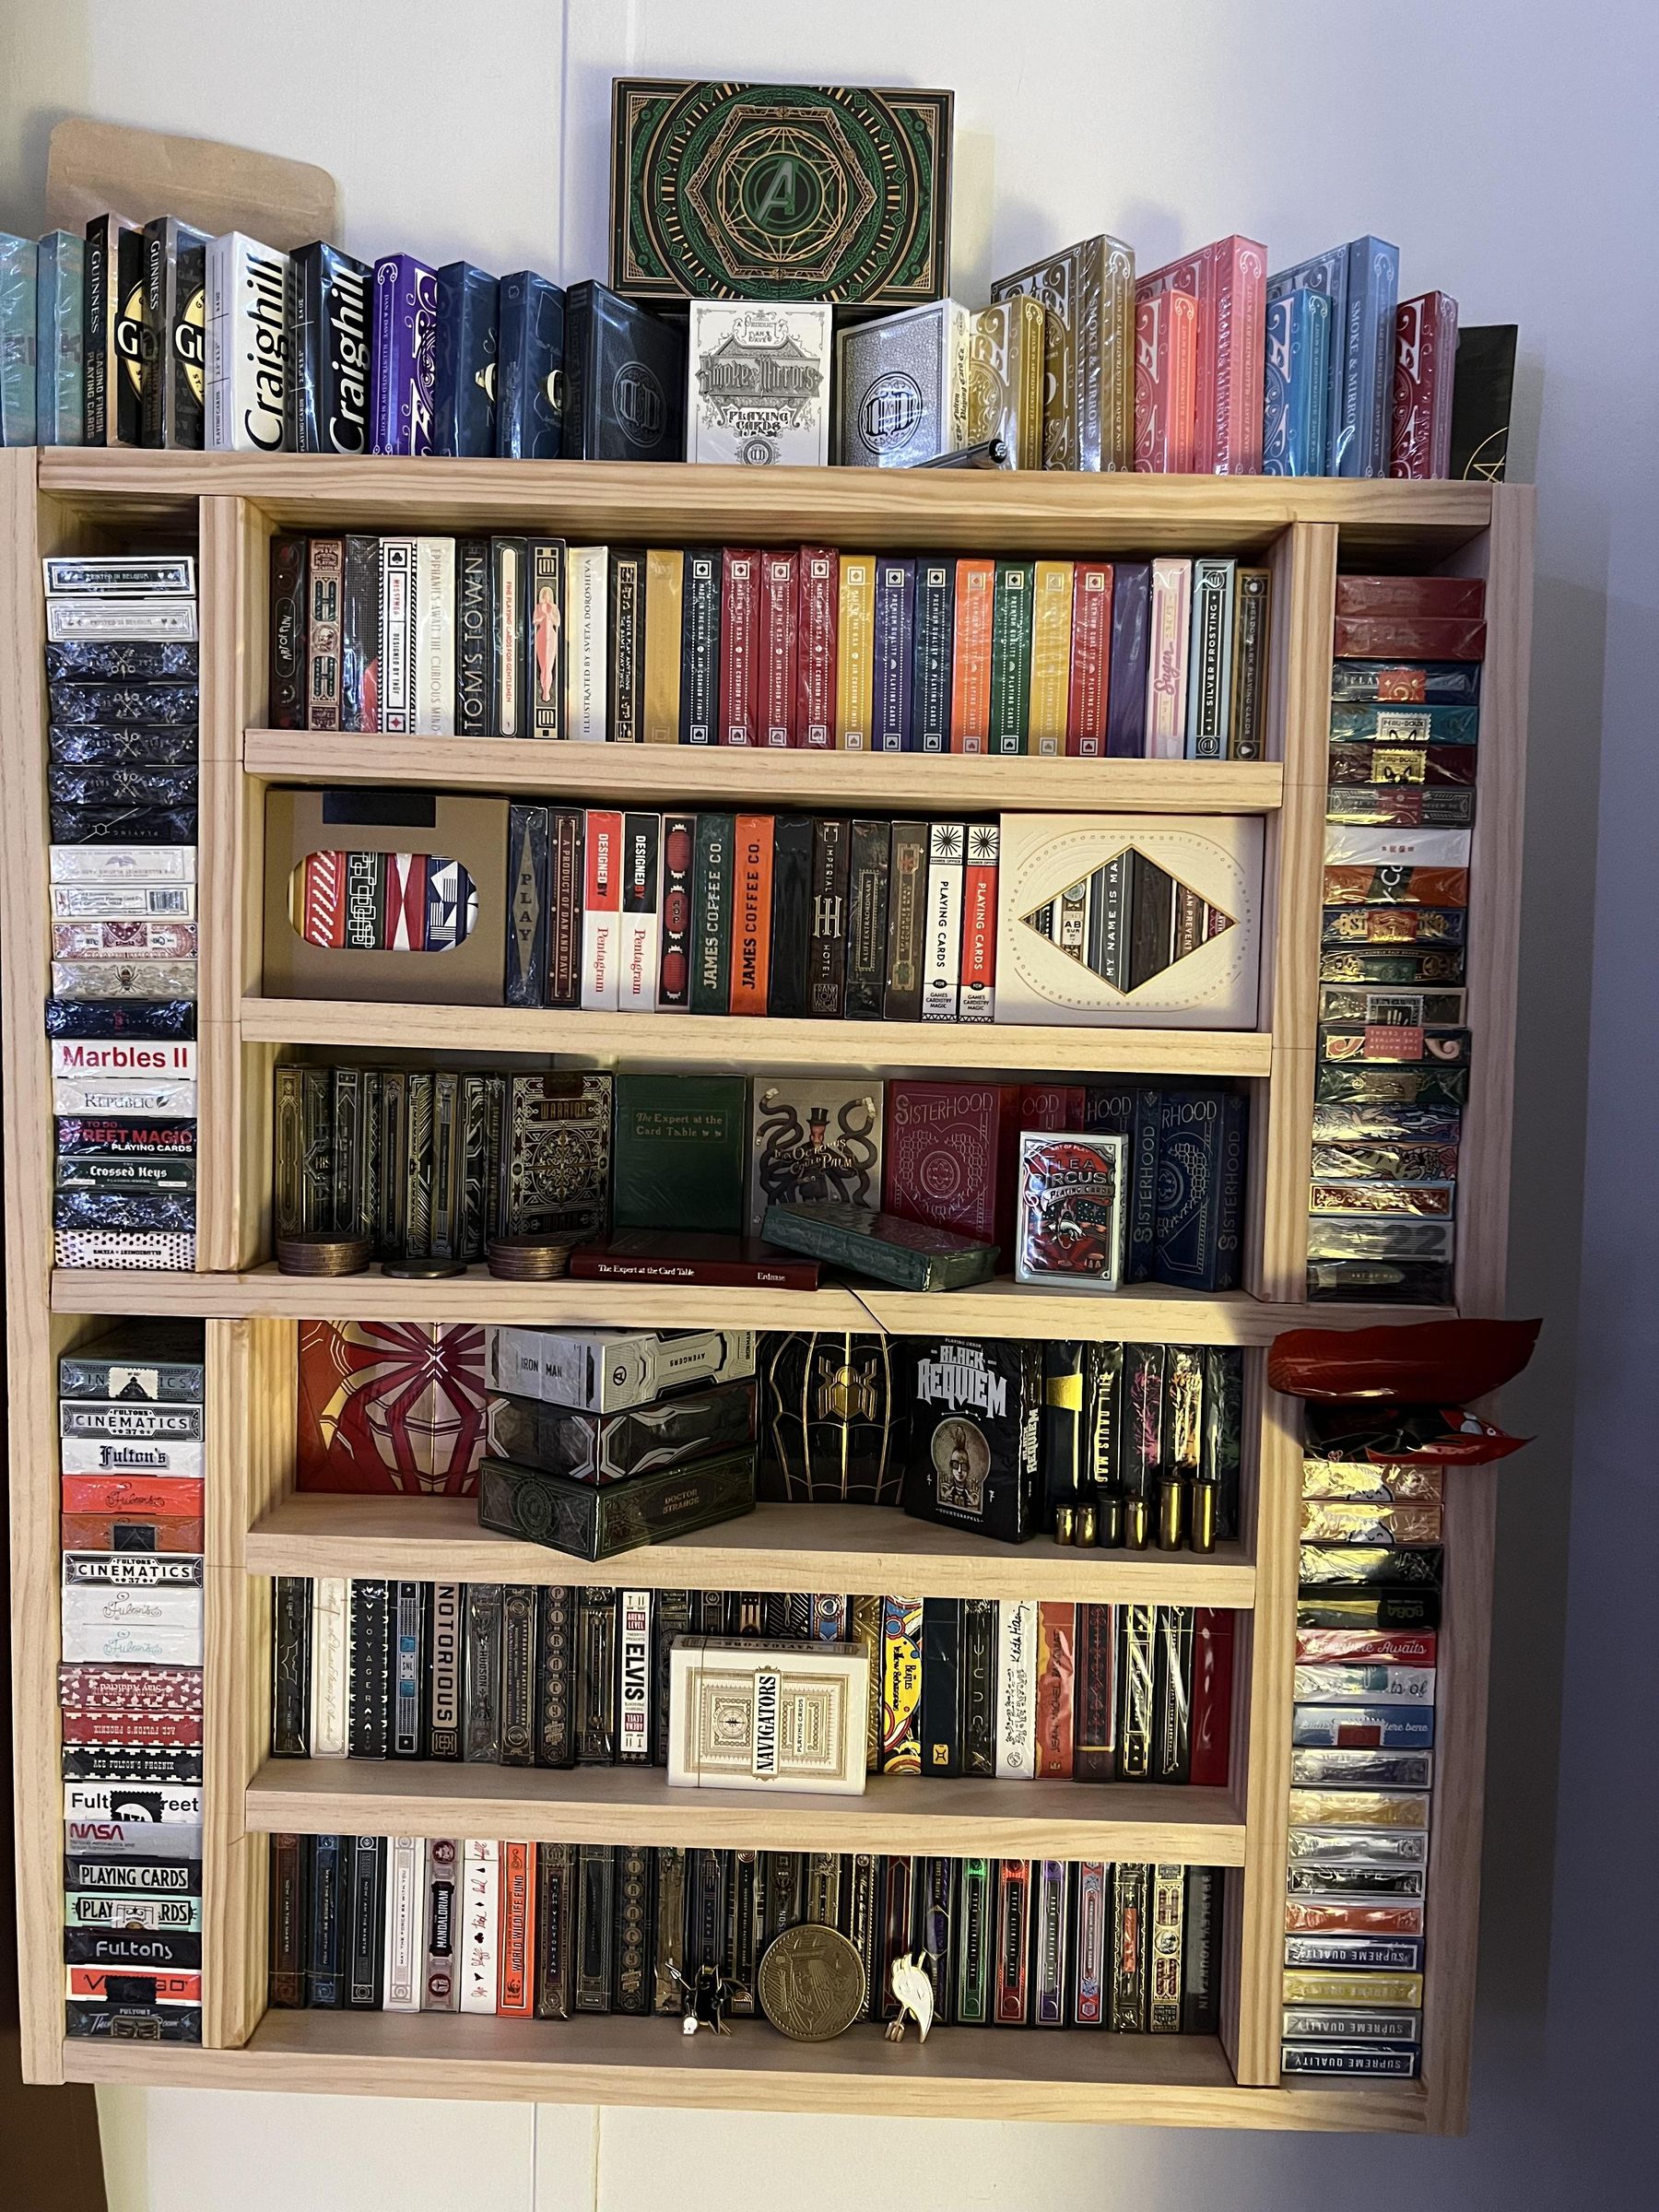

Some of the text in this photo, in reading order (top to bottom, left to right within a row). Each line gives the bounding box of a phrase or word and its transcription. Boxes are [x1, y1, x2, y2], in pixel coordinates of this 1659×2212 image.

[149, 240, 161, 311] GUINNESS
[91, 251, 101, 334] GUINNESS
[1349, 300, 1361, 355] SMOKE
[244, 252, 290, 452] Craighill
[329, 261, 371, 454] Craighill
[1348, 359, 1358, 370] &
[1088, 299, 1099, 439] SMOKE & MIRRORS
[86, 351, 96, 440] PLAYING CARDS
[95, 348, 104, 434] CASINO FINISH
[729, 411, 789, 423] PLAYING
[736, 421, 782, 435] CARDS
[584, 559, 593, 619] DOROSHEVA
[430, 548, 441, 733] EPIPHANIES AWAIT THE CURIOUS MIND
[464, 557, 483, 729] TOM'S TOWN
[583, 654, 591, 667] BY
[1153, 641, 1180, 696] Sugar
[1383, 719, 1425, 728] PEAU-DOUX
[561, 850, 571, 894] PRODUCT
[825, 844, 834, 892] IMPERIAL
[520, 873, 532, 942] PLAY
[561, 897, 570, 908] OF
[703, 837, 723, 990] JAMES COFFEE CO.
[742, 837, 761, 991] JAMES COFFEE CO.
[561, 912, 570, 930] DAN
[936, 880, 949, 968] PLAYING CARDS
[973, 882, 987, 971] PLAYING CARDS
[1064, 920, 1081, 929] AB
[560, 933, 569, 953] AND
[559, 955, 568, 980] DAVE
[594, 926, 609, 993] Pentagram
[632, 928, 647, 995] Pentagram
[821, 943, 830, 978] HOTEL
[63, 1045, 188, 1069] Marbles II
[85, 1091, 155, 1109] REPUBLIC
[894, 1092, 994, 1126] SISTERHOOD
[636, 1112, 724, 1126] The Expert at the
[636, 1125, 698, 1137] Card Table
[59, 1128, 194, 1146] STREET MAGIC
[112, 1143, 194, 1153] PLAYING CARDS
[89, 1165, 168, 1180] Crossed Keys
[1133, 1125, 1156, 1244] SISTERHOOD
[1218, 1130, 1241, 1251] SISTERHOOD
[598, 1264, 612, 1274] The
[613, 1265, 638, 1277] Expert
[647, 1266, 657, 1275] the
[658, 1266, 676, 1277] Card
[676, 1267, 695, 1277] Table
[520, 1358, 562, 1379] IRON MAN
[669, 1352, 706, 1368] AVENGERS
[939, 1346, 985, 1371] BLACK
[916, 1358, 1007, 1419] REQUIEM
[76, 1415, 188, 1430] CINEMATICS
[1026, 1407, 1041, 1474] REQUIEM
[99, 1445, 167, 1467] Fulton's
[665, 1488, 698, 1504] DOCTOR
[77, 1564, 191, 1578] CINEMATICS
[627, 1612, 646, 1621] ARENA
[627, 1621, 645, 1630] LEVEL
[364, 1614, 372, 1702] VOYAGER
[435, 1584, 455, 1722] NOTORIOUS
[723, 1641, 815, 1650] NAVIGATORS
[1377, 1640, 1428, 1655] Awaits
[401, 1661, 413, 1672] SNL
[478, 1650, 488, 1688] HUDSON
[625, 1642, 646, 1701] ELVIS
[903, 1665, 916, 1690] BEATLES
[1052, 1681, 1062, 1720] MICHEL
[1409, 1679, 1429, 1698] of
[93, 1724, 176, 1735] ACE FULTON'S PHOENIX
[625, 1713, 644, 1723] LEVEL
[625, 1722, 644, 1732] ARENA
[756, 1675, 777, 1771] NAVIGATORS
[1051, 1724, 1062, 1753] JEAN
[93, 1759, 175, 1771] ACE FULTON'S PHOENIX
[70, 1822, 124, 1841] NASA
[81, 1867, 187, 1888] PLAYING CARDS
[436, 1889, 449, 1948] MANDALORIAN
[512, 1875, 524, 1971] WORLD WILDLIFE FUND
[1199, 1874, 1212, 2010] BRADLEY MOUNTAIN
[1297, 2020, 1404, 2034] SUPREME QUALITY
[1294, 2055, 1402, 2069] SUPREME QUALITY
